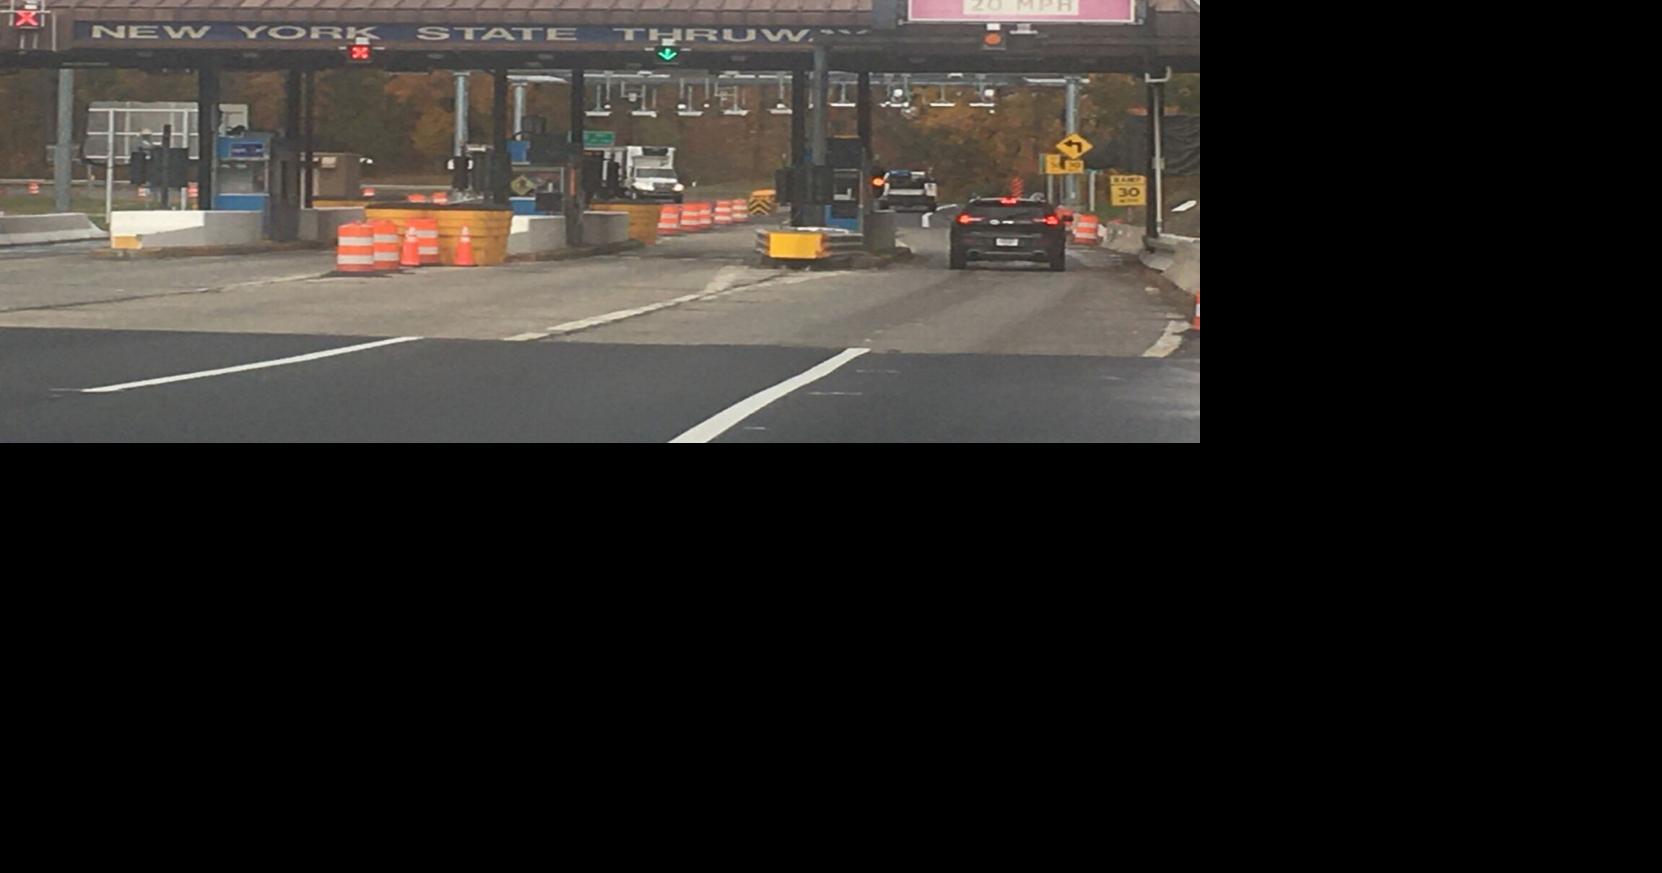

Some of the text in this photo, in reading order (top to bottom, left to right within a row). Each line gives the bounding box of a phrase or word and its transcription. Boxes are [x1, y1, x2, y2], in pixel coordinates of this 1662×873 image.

[970, 0, 1074, 12] 20 MPH
[91, 24, 868, 43] NEW YORK STATE THRUW
[1118, 187, 1140, 198] 30
